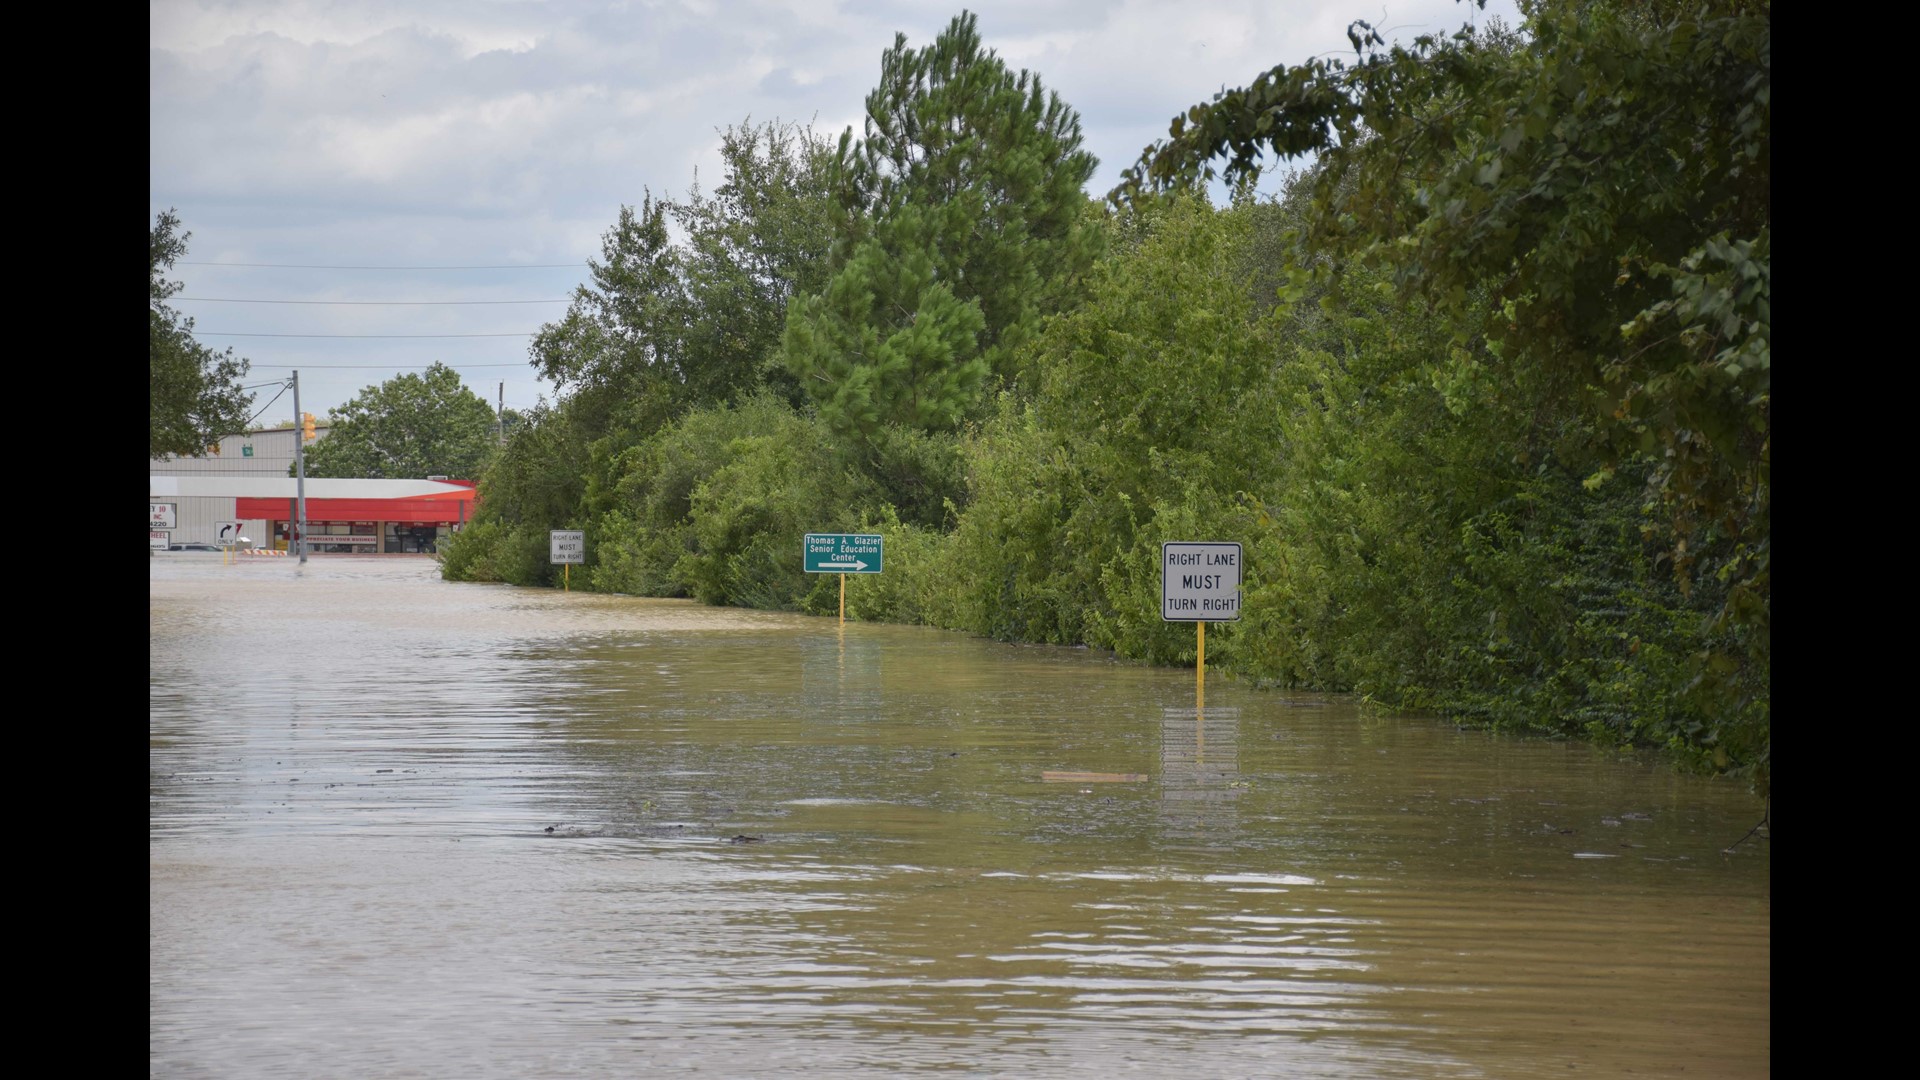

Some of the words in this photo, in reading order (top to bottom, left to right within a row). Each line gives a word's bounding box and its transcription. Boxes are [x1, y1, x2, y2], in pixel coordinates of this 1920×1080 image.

[807, 537, 835, 545] Thomas
[842, 537, 848, 545] A.
[855, 537, 881, 545] Glazier
[810, 545, 834, 553] Senior
[831, 553, 856, 561] Center
[1169, 554, 1201, 565] RIGHT
[1207, 554, 1235, 565] LANE
[1183, 575, 1221, 589] MUST
[1169, 599, 1197, 610] TURN
[1203, 599, 1235, 610] RIGHT
